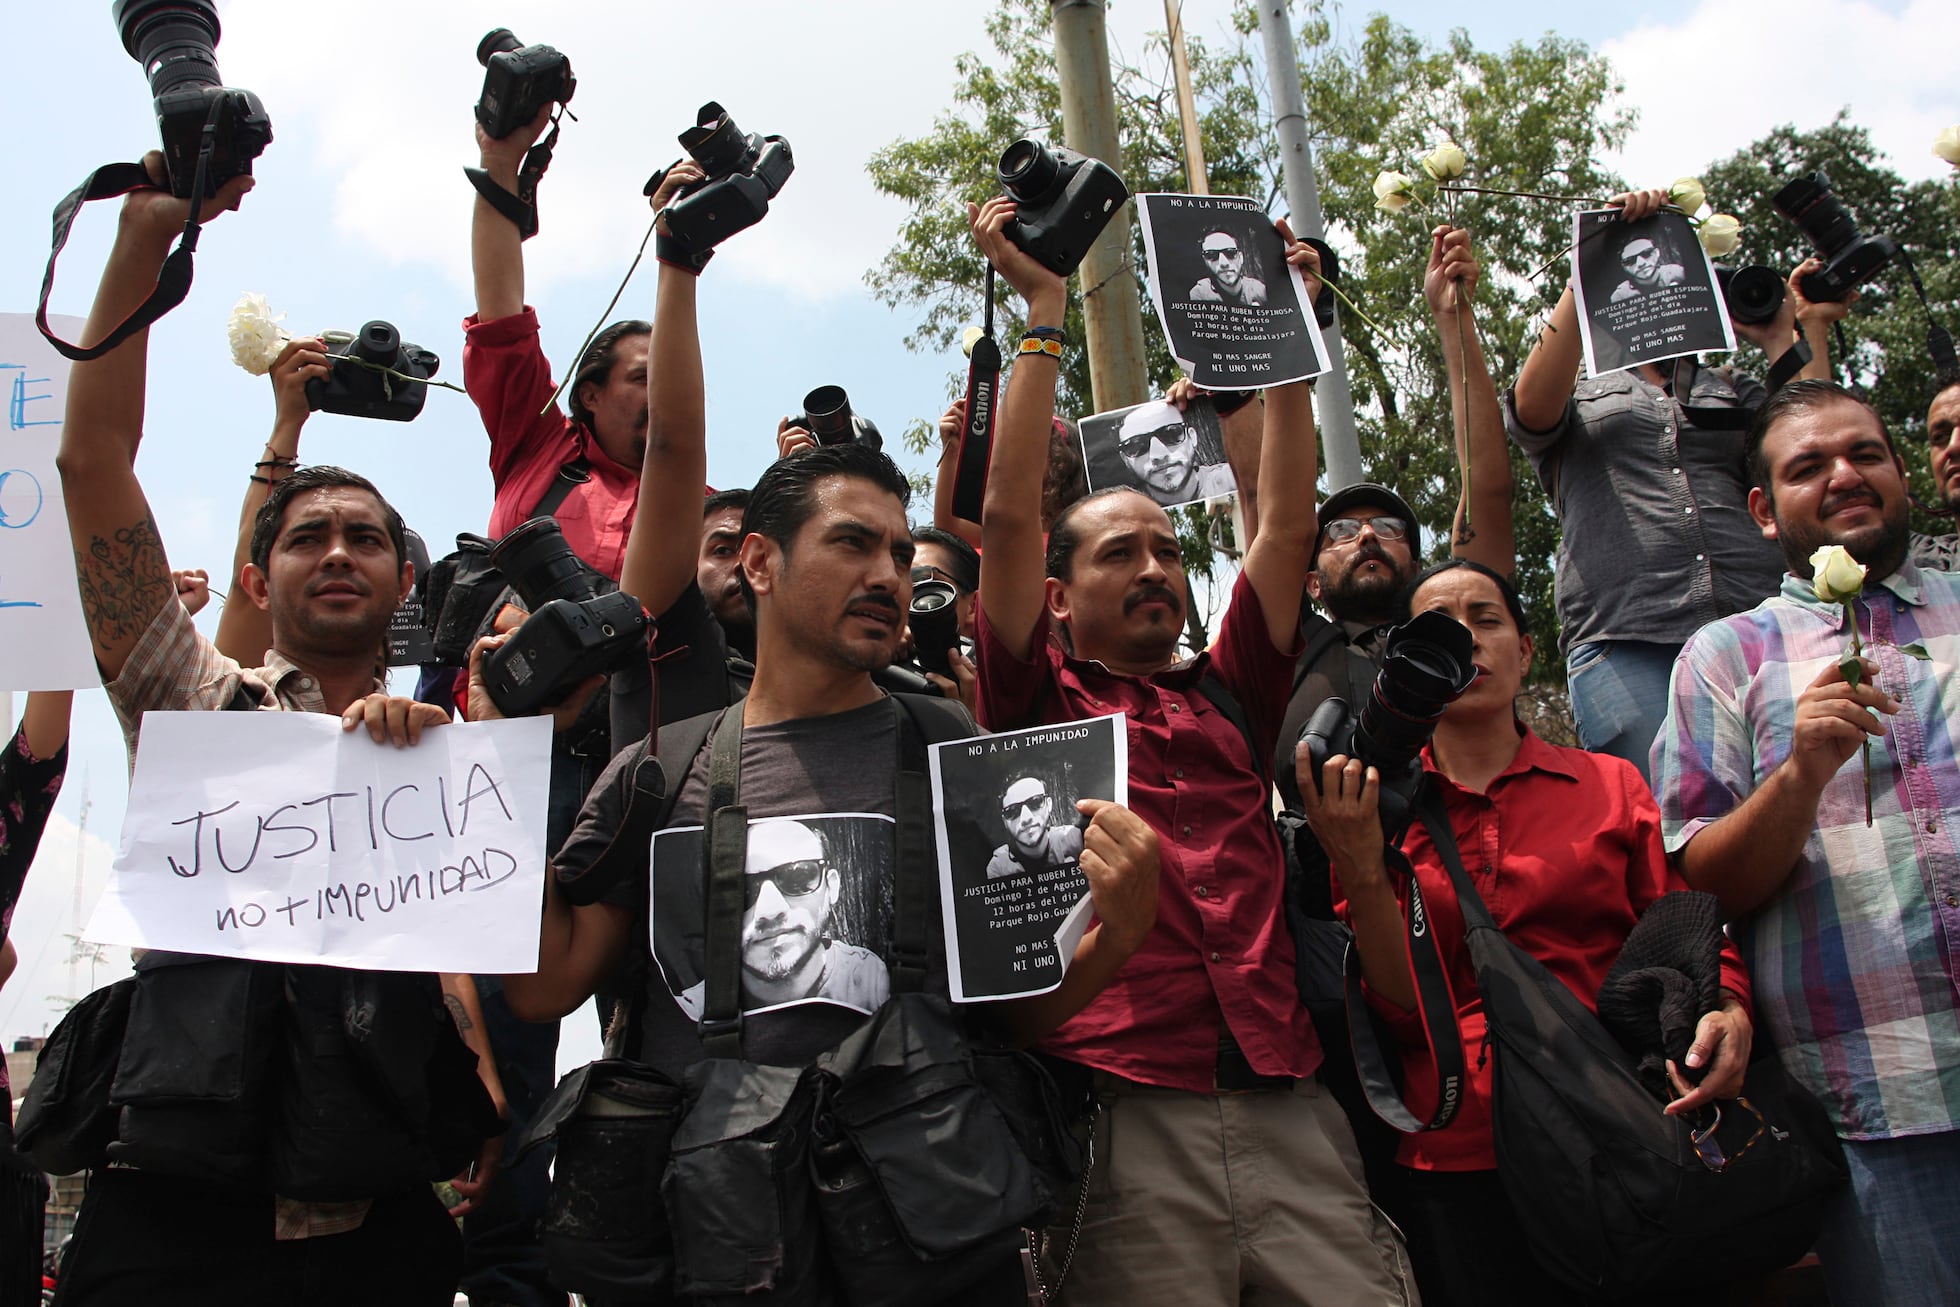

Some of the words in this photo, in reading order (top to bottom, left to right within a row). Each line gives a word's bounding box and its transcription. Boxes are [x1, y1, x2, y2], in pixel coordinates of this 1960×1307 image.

[1170, 199, 1182, 207] NO
[1199, 201, 1211, 209] LA
[1216, 202, 1264, 213] IMPUNIDAD
[1598, 215, 1607, 223] NO
[1594, 302, 1626, 316] JUSTICIA
[1630, 296, 1646, 306] PARA
[1650, 290, 1671, 300] RUBEN
[1674, 286, 1708, 294] ESPINOSA
[1608, 306, 1638, 318] Domingo
[1661, 294, 1686, 303] Agosto
[1170, 302, 1207, 310] JUSTICIA
[1211, 304, 1228, 312] PARA
[1232, 307, 1252, 316] RUBEN
[1256, 307, 1294, 316] ESPINOSA
[1626, 310, 1648, 320] horas
[1650, 304, 1663, 312] del
[1187, 312, 1218, 320] Domingo
[1230, 314, 1239, 322] de
[1243, 315, 1270, 324] Agosto
[1208, 322, 1228, 330] horas
[1612, 320, 1638, 332] Parque
[1660, 324, 1686, 334] SANGRE
[1192, 330, 1218, 339] Parque
[1630, 344, 1640, 352] NI
[1646, 339, 1662, 348] UNO
[1667, 334, 1684, 343] MAS
[1244, 352, 1272, 360] SANGRE
[1212, 364, 1222, 372] NI
[1229, 364, 1247, 372] UNO
[1252, 363, 1270, 372] MAS
[972, 382, 990, 436] Canon
[968, 745, 982, 756] NO
[990, 744, 997, 752] A
[1004, 740, 1018, 750] LA
[1025, 728, 1089, 746] IMPUNIDAD
[168, 763, 513, 878] JUSTICIA
[964, 882, 1007, 897] JUSTICIA
[1011, 876, 1034, 888] PARA
[1038, 869, 1066, 882] RUBEN
[1070, 866, 1084, 876] ES
[984, 891, 1022, 906] Domingo
[1026, 888, 1032, 896] 2
[1038, 885, 1048, 894] de
[1054, 878, 1086, 892] Agosto
[994, 906, 1004, 916] 12
[1009, 901, 1036, 913] horas
[1040, 896, 1056, 906] del
[1411, 876, 1426, 937] Canon
[990, 916, 1022, 929] Parque
[1015, 943, 1027, 954] NO
[1032, 940, 1048, 951] MAS
[1013, 960, 1027, 972] NI
[1034, 954, 1054, 968] UNO
